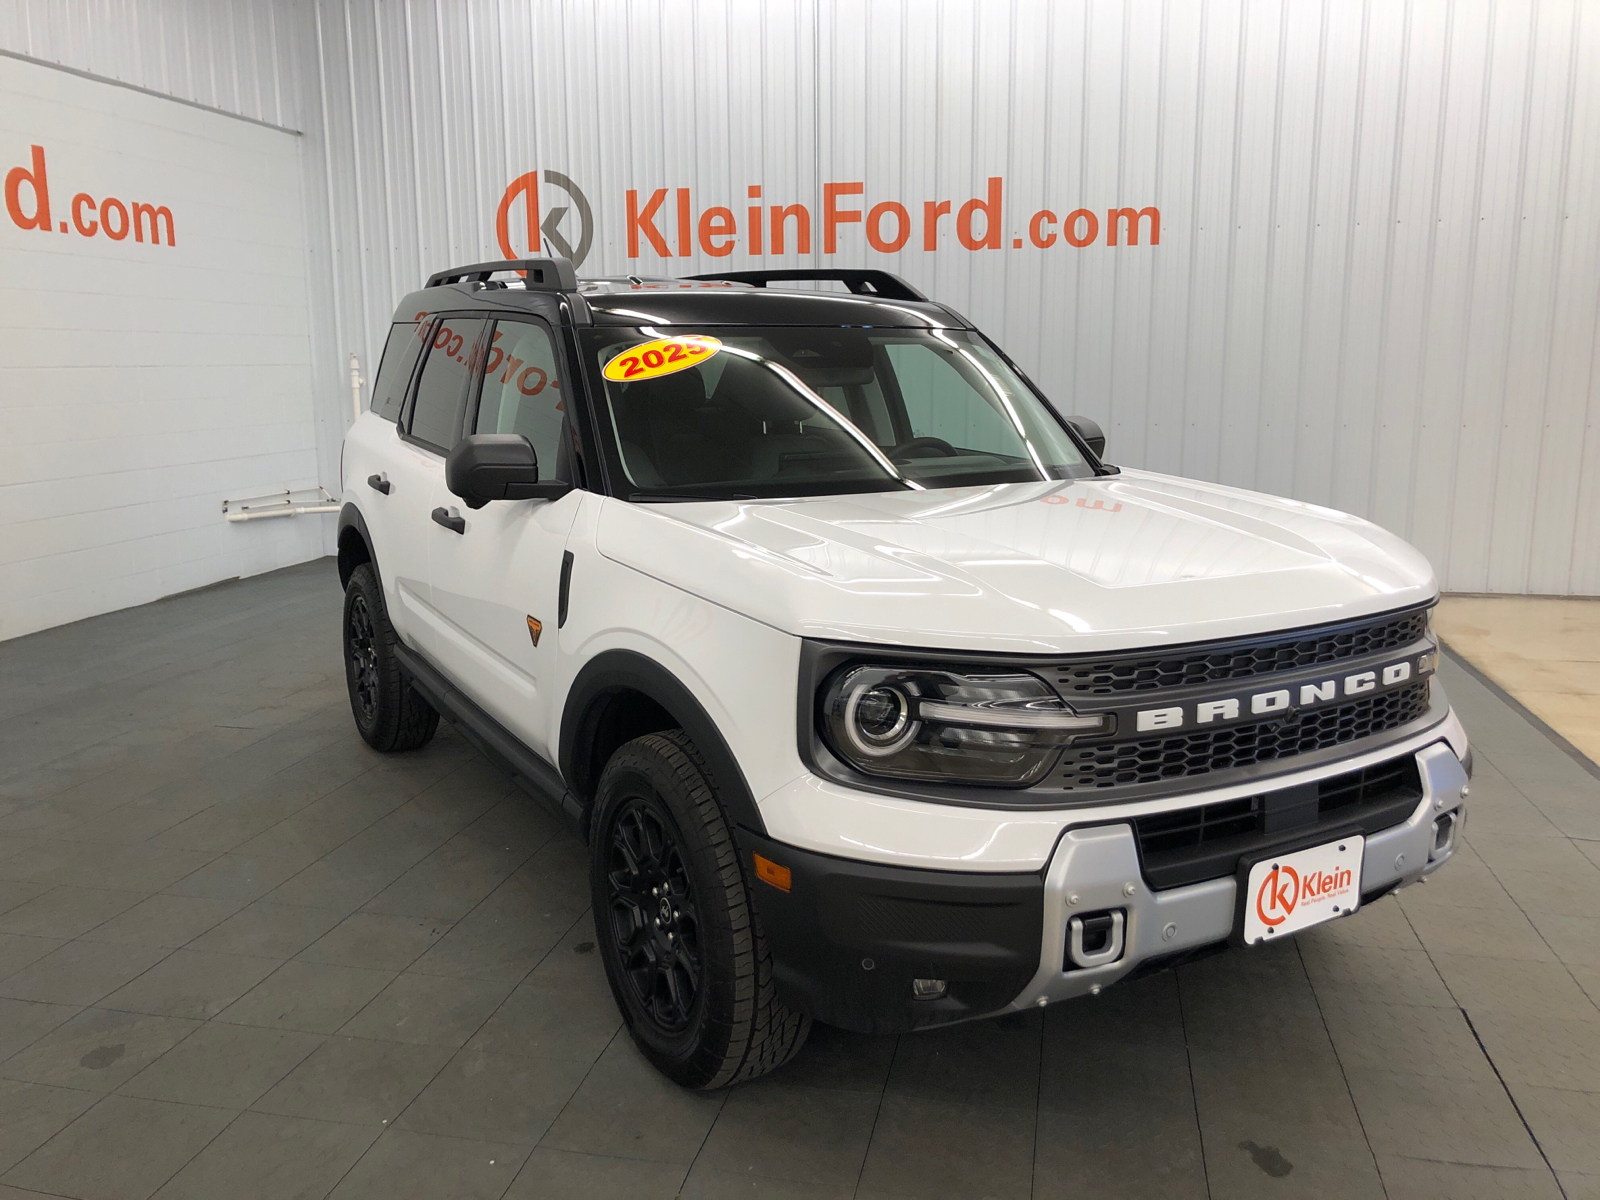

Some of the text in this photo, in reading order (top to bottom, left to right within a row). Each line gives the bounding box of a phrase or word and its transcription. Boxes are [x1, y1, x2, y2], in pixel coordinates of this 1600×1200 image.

[626, 178, 1160, 257] KleinFord.com
[619, 338, 707, 378] 2025
[1137, 662, 1411, 732] BRONCO
[1302, 866, 1351, 899] Klein
